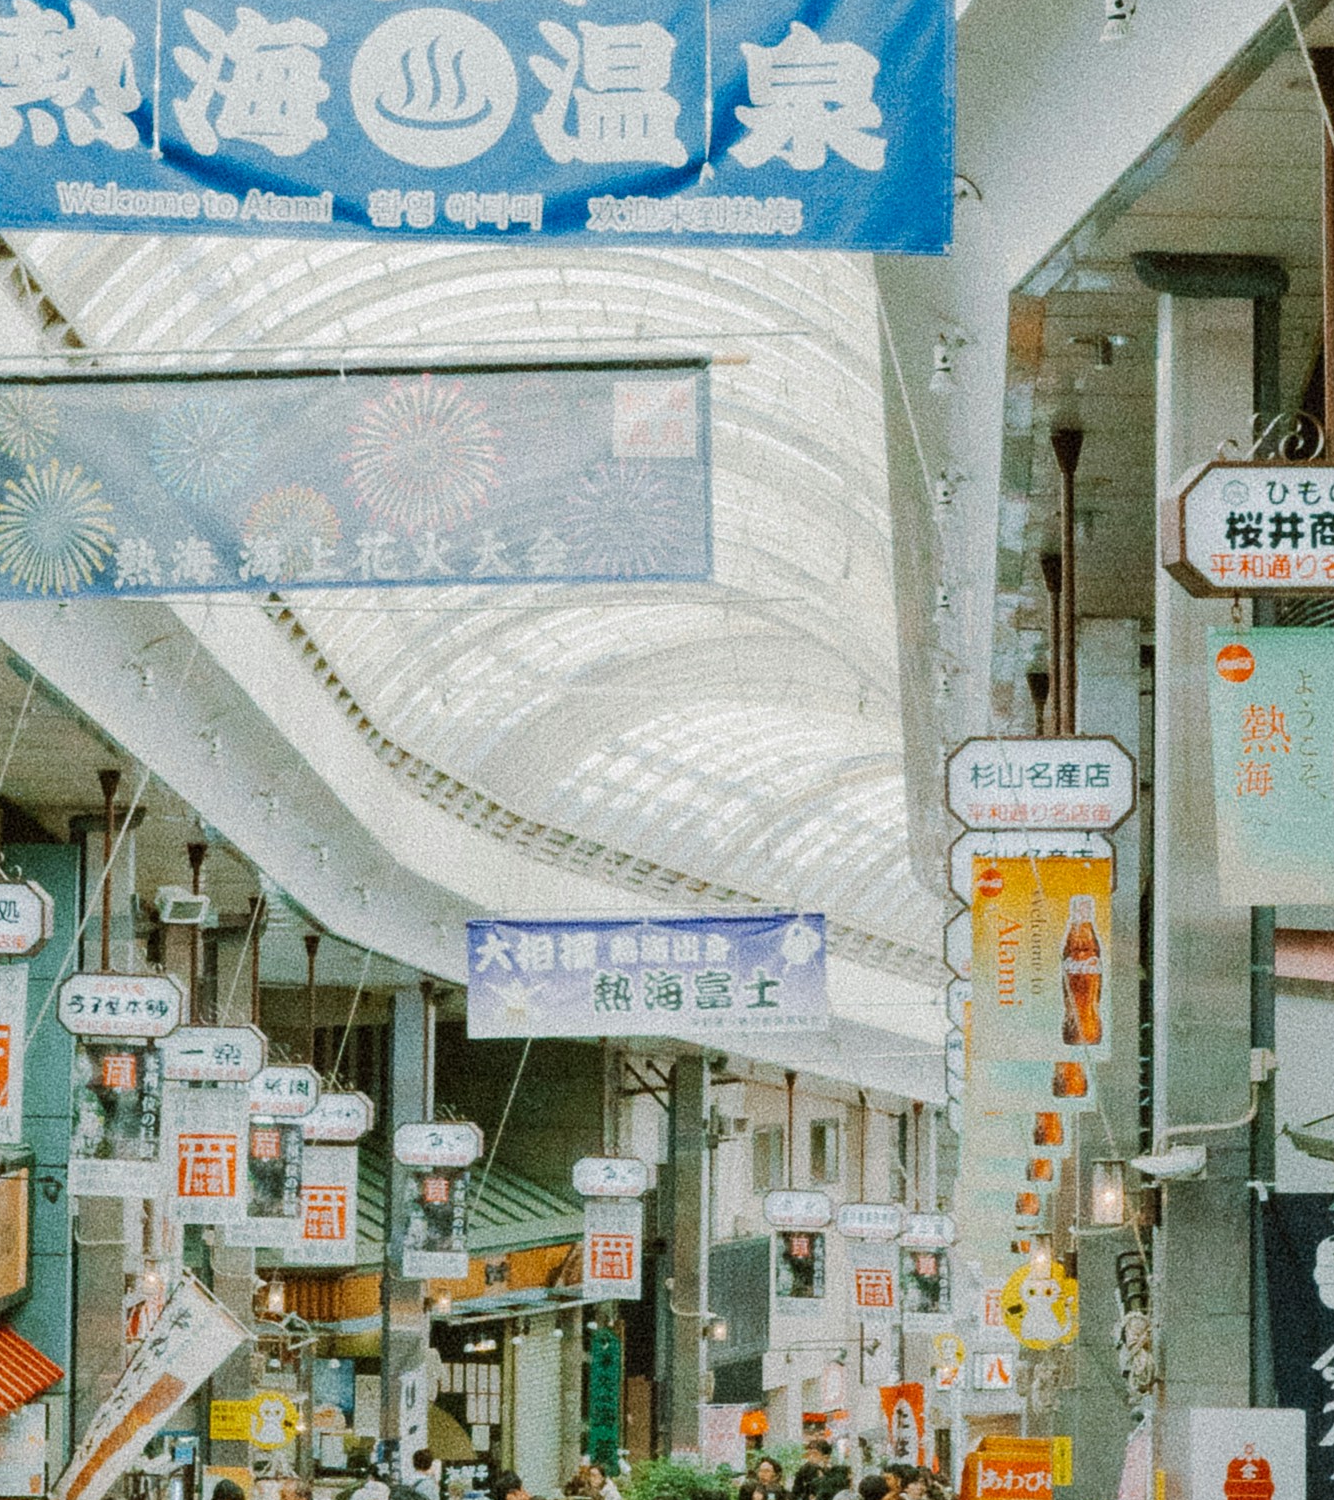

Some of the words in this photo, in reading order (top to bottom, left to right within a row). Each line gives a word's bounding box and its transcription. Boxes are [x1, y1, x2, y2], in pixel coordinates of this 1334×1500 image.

[527, 17, 888, 173] 温泉
[56, 182, 196, 220] Welcome
[202, 189, 235, 221] to
[239, 189, 335, 224] Atami
[969, 761, 1112, 790] 杉山名産店
[593, 968, 781, 1014] 熱海富士
